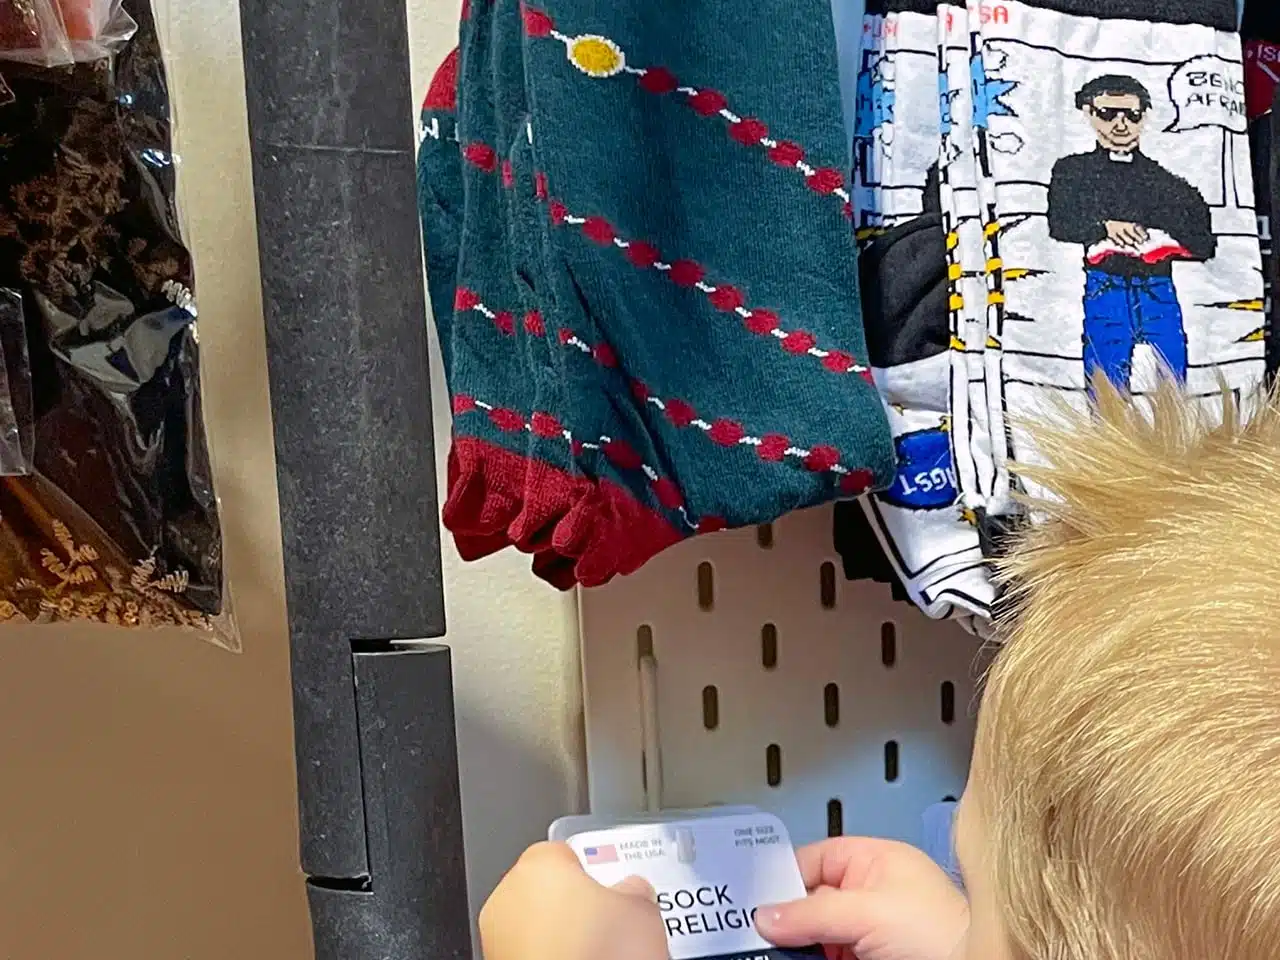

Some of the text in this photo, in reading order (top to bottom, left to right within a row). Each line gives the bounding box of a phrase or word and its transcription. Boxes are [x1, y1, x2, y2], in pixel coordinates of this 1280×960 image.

[979, 5, 1008, 24] SA
[657, 884, 733, 912] SOCK
[665, 906, 758, 937] RELIGI
